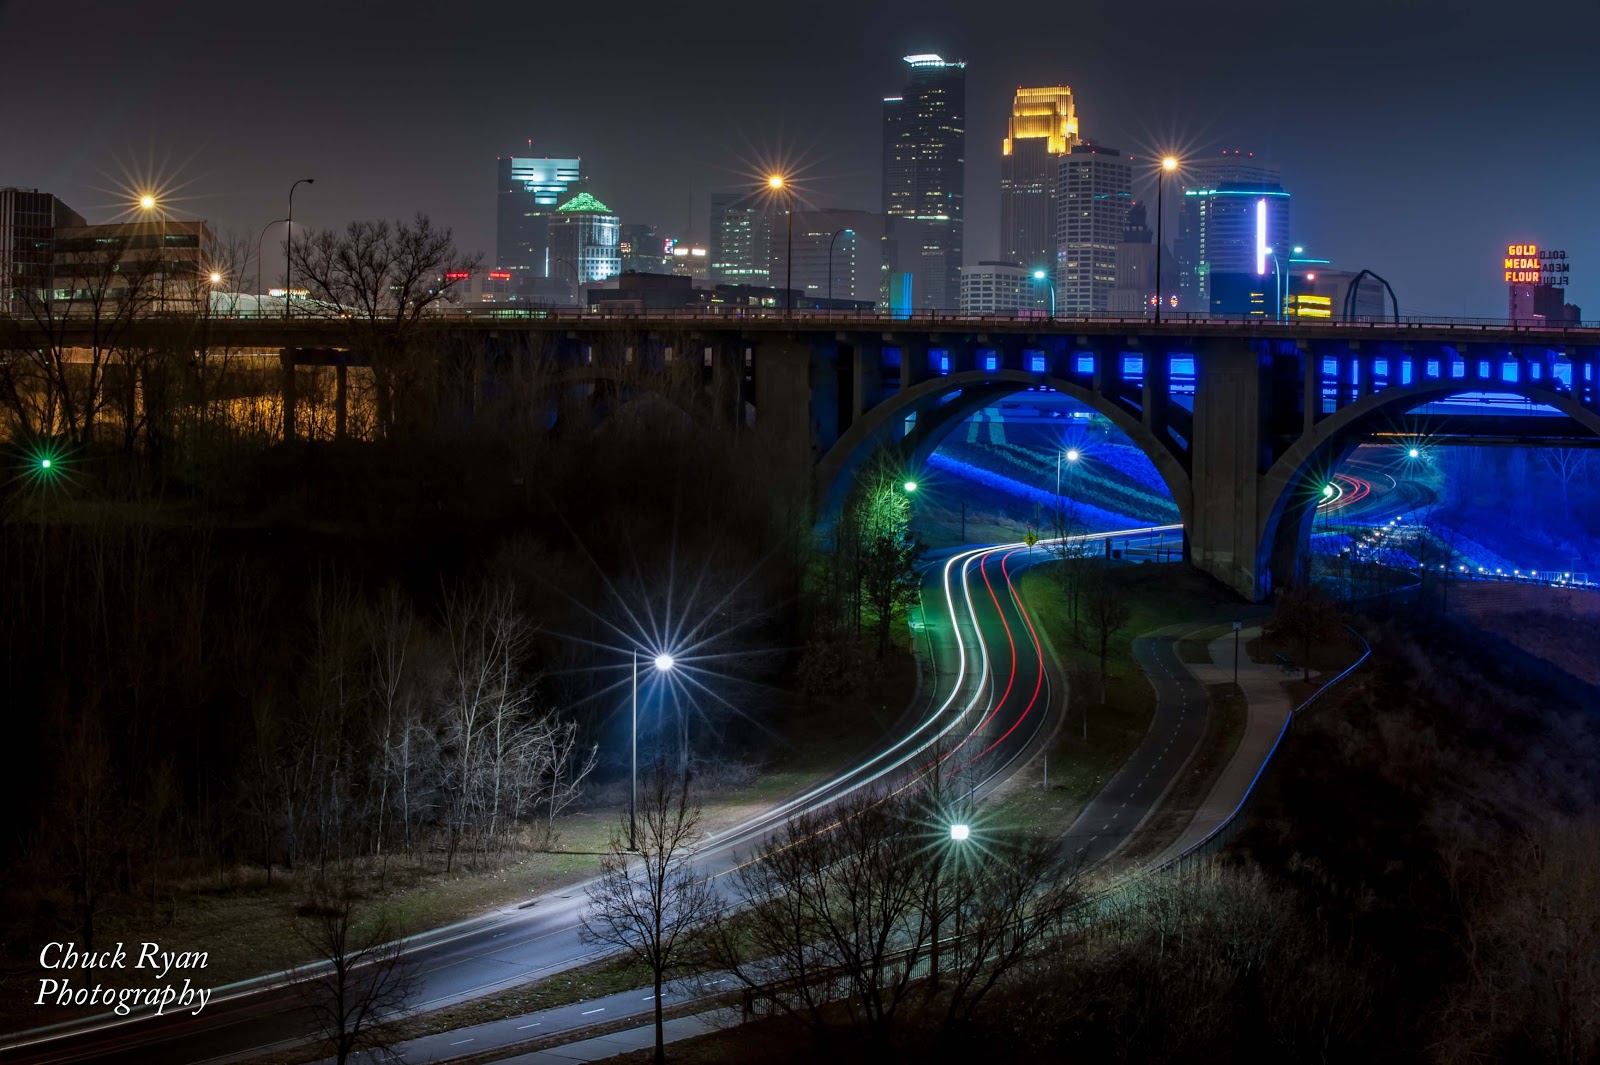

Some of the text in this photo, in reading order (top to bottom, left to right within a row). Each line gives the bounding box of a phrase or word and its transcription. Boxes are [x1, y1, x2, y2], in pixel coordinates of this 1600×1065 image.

[1508, 245, 1536, 256] GOLD
[1504, 258, 1541, 269] MEDAL
[1505, 271, 1540, 282] FLOUR
